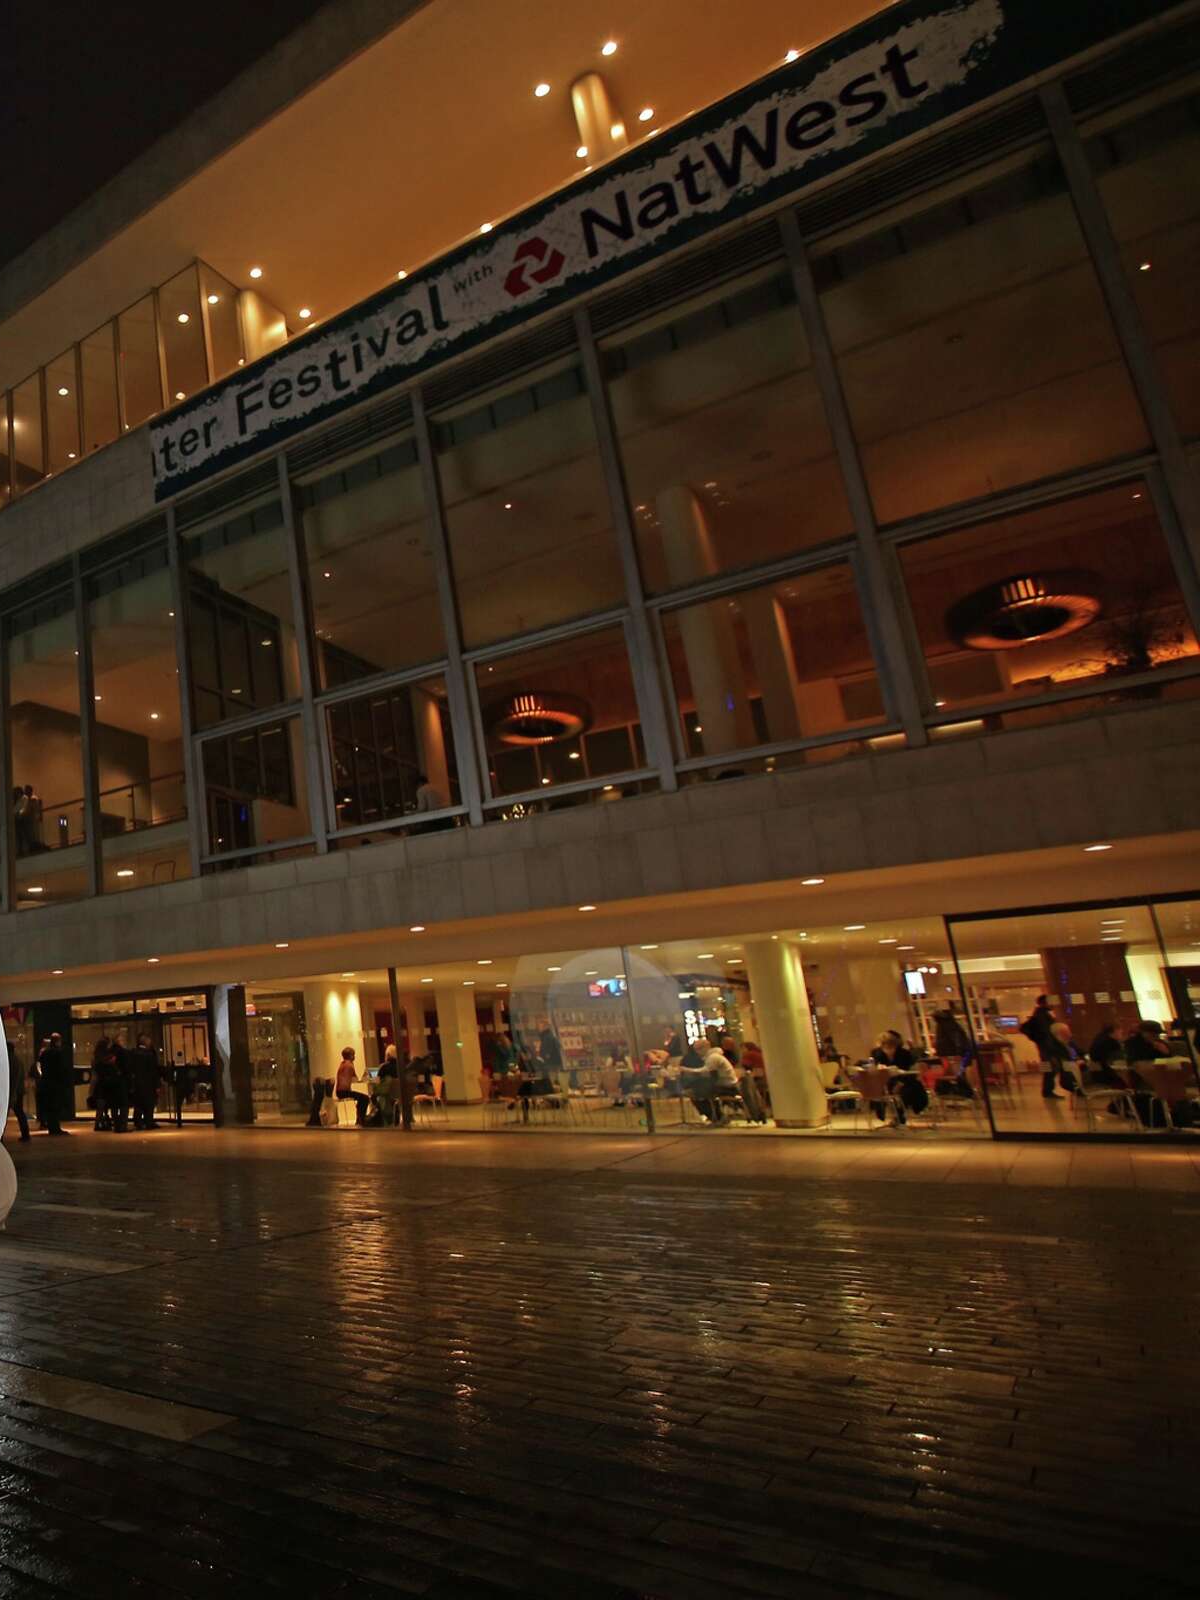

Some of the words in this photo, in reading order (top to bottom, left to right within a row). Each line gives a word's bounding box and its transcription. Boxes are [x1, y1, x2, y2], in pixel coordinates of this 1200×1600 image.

[152, 417, 217, 476] ter
[235, 284, 449, 435] Festival
[452, 264, 493, 293] with
[580, 44, 929, 258] NatWest
